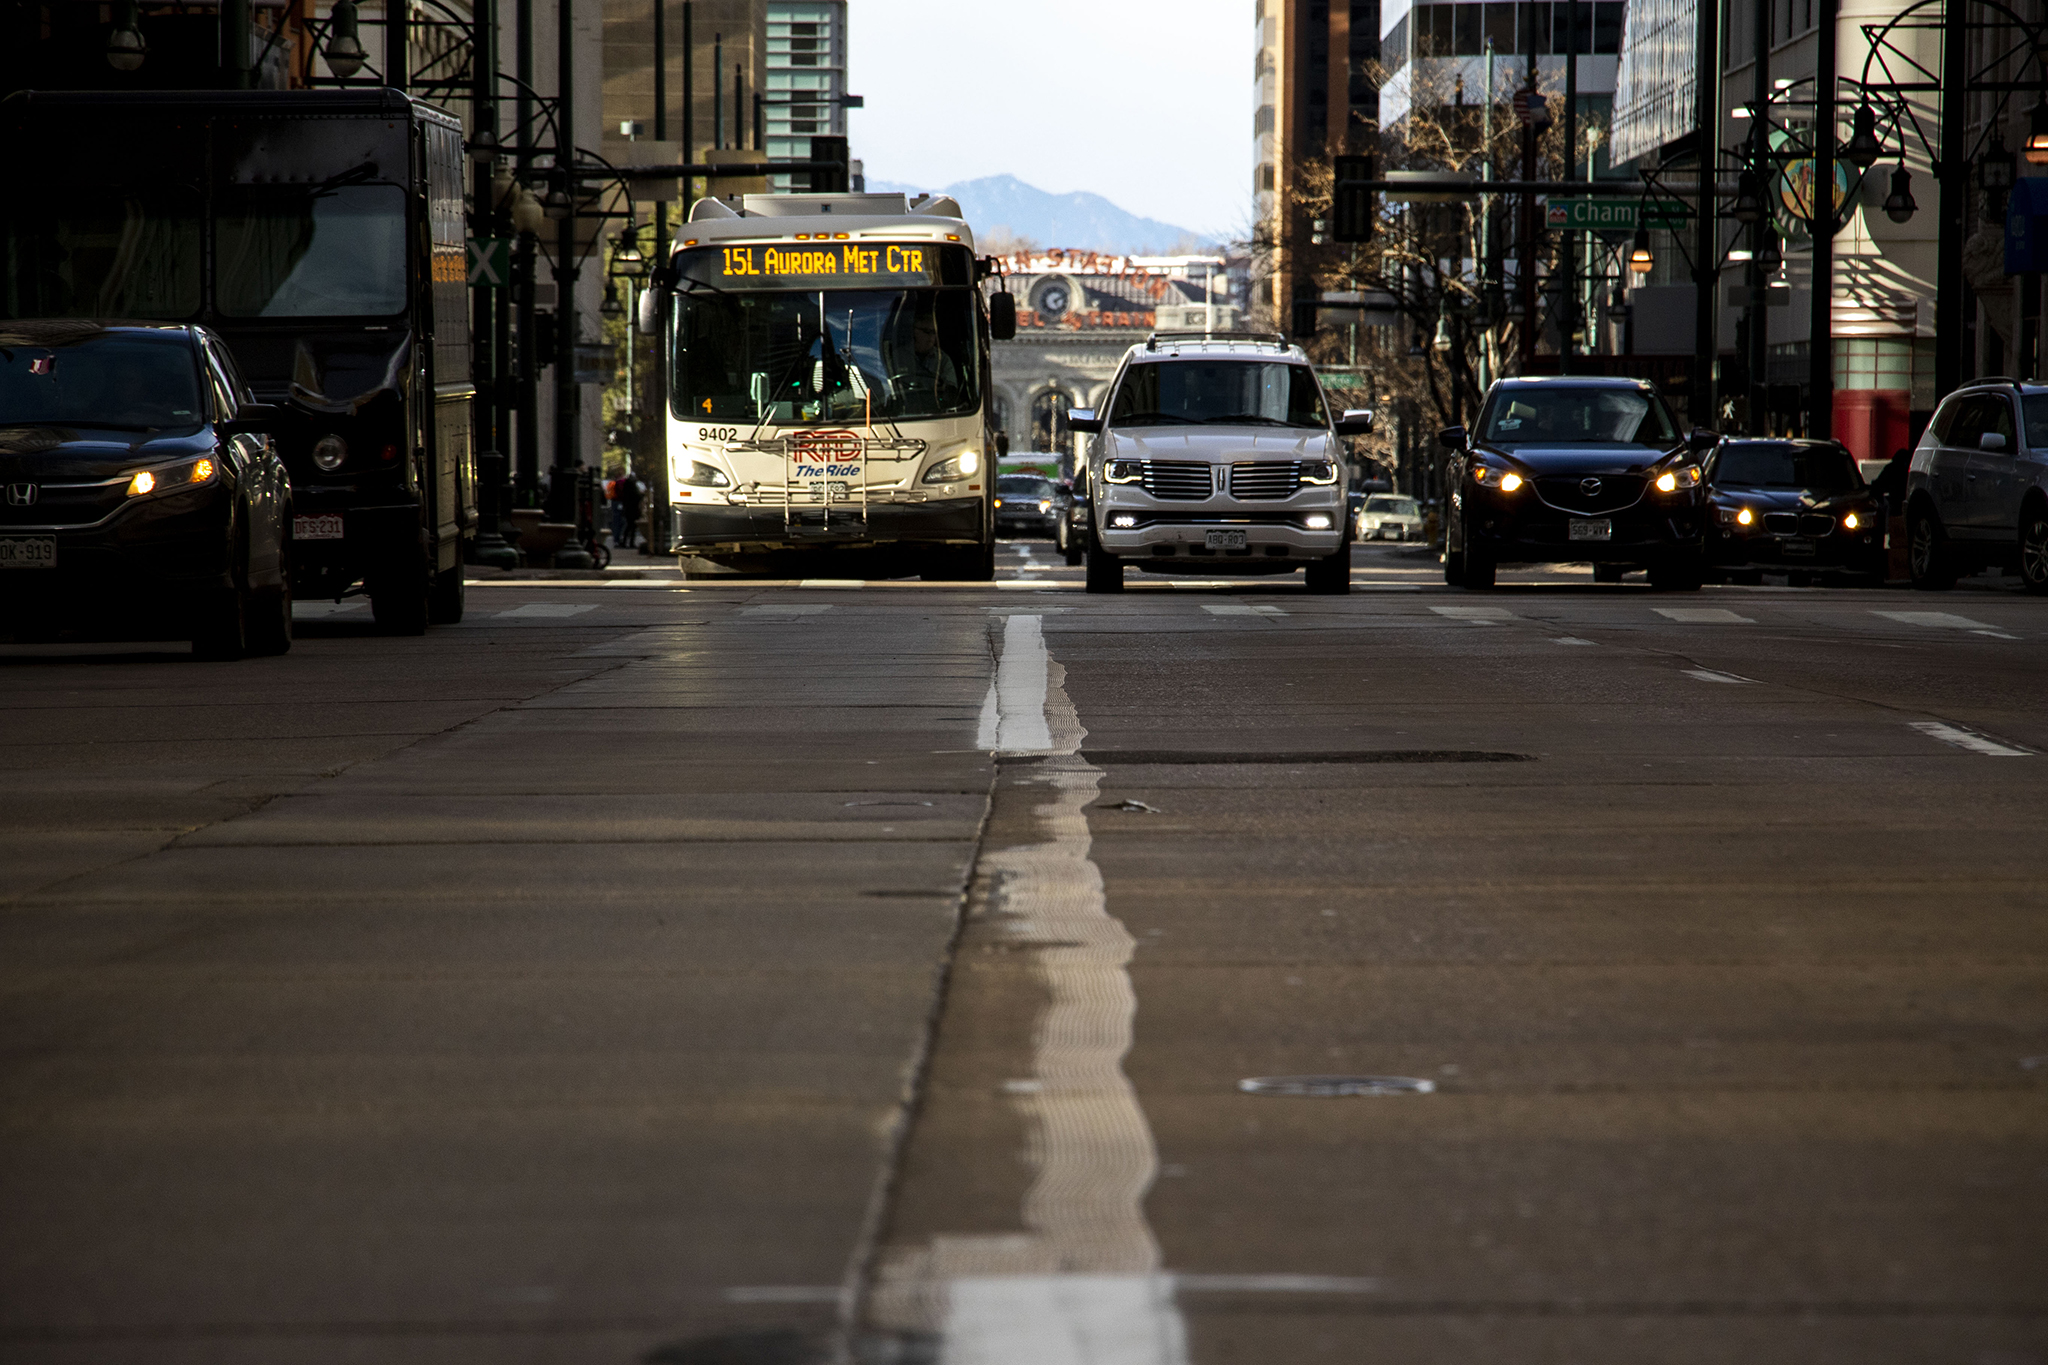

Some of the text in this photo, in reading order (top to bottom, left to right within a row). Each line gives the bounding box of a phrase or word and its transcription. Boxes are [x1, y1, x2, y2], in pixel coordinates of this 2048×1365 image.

[1573, 202, 1659, 227] Champa
[723, 247, 760, 275] 15L
[1046, 248, 1169, 300] STATION
[1087, 311, 1156, 327] TRAIN
[702, 398, 713, 413] 4
[699, 428, 738, 441] 9402
[793, 430, 862, 463] RTD
